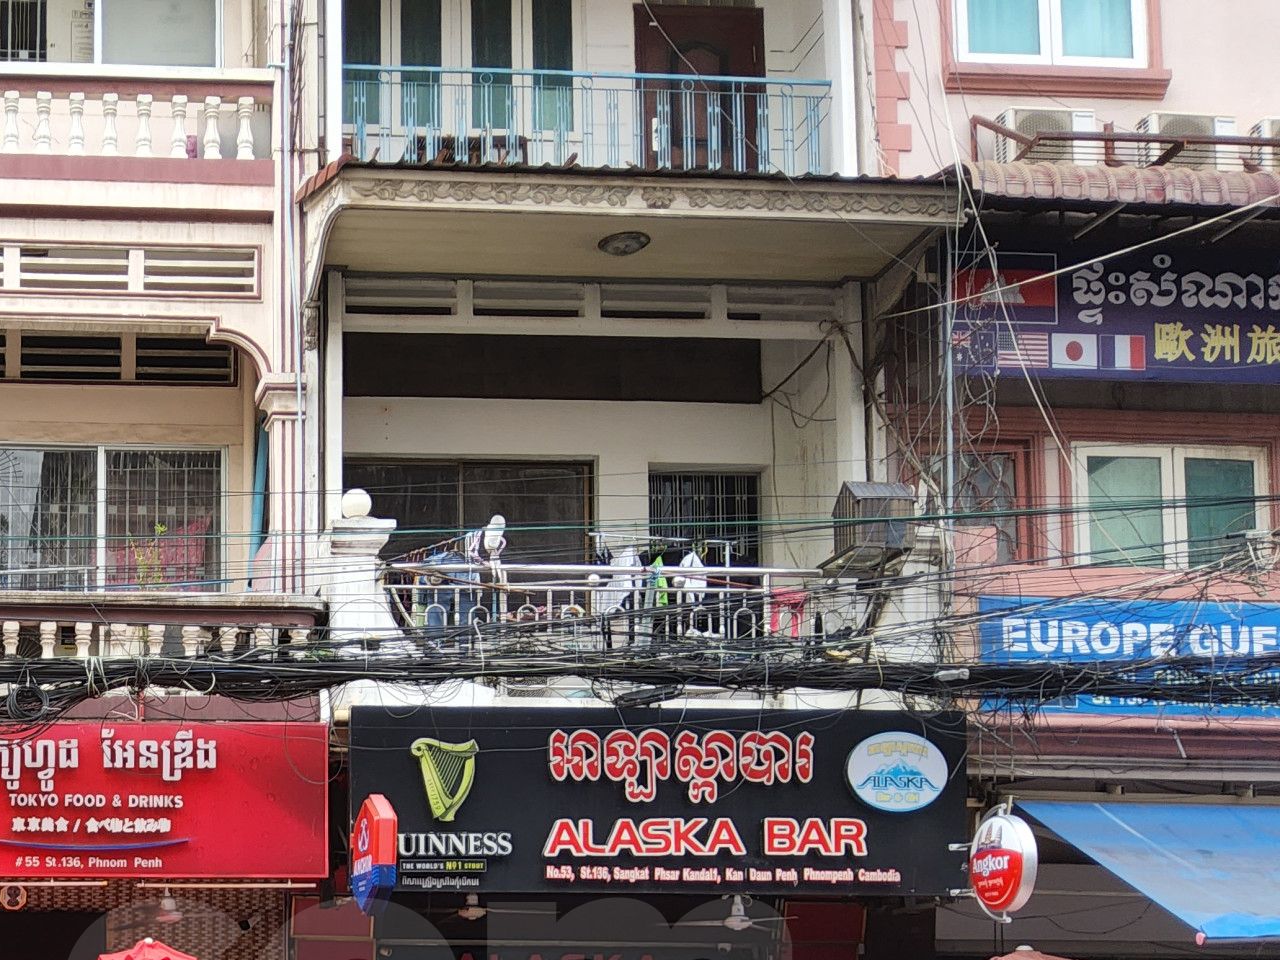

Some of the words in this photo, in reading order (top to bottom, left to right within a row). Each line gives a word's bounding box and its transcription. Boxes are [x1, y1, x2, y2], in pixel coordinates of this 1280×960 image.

[1002, 617, 1175, 656] EUROPE
[9, 793, 59, 807] TOKYO
[64, 793, 106, 807] FOOD
[112, 794, 122, 807] &
[128, 794, 184, 808] DRINKS
[397, 832, 513, 856] UINNESS
[543, 818, 747, 857] ALASKA
[764, 817, 868, 856] BAR
[45, 857, 84, 869] St.136,
[88, 857, 127, 868] Phnom
[134, 857, 162, 868] Penh
[464, 862, 484, 870] STOUT
[972, 854, 1010, 877] Angkor
[546, 865, 575, 882] No.53,
[613, 867, 650, 882] Sangkat
[654, 867, 680, 880] Phsar
[749, 868, 772, 881] Daun
[803, 867, 854, 883] Phnompenh
[858, 868, 901, 882] Cambodia
